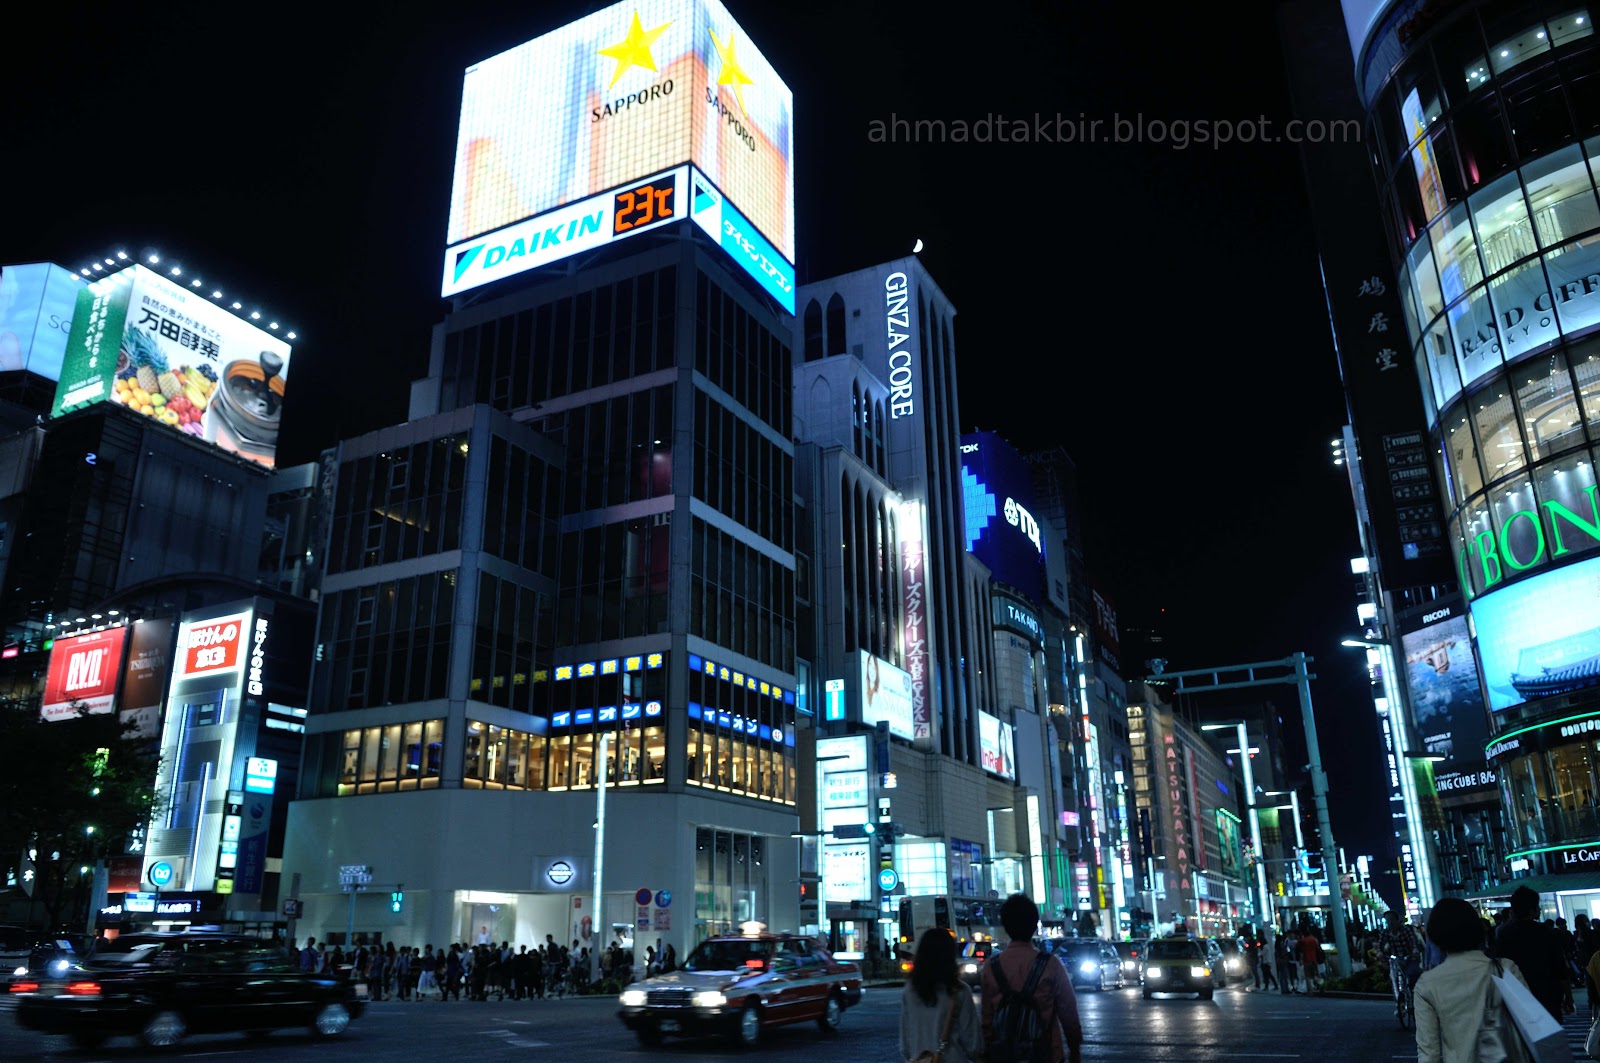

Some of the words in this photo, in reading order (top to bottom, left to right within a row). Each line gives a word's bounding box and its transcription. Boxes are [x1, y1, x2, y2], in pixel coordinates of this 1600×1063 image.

[592, 79, 674, 123] SAPPORO
[705, 87, 756, 152] SAPPORO
[483, 210, 604, 270] DAIKIN
[885, 271, 911, 350] GINZA
[1358, 275, 1399, 372] 鳩居堂
[138, 306, 220, 363] 万田酵素
[1480, 316, 1550, 362] TOKYO
[888, 349, 914, 420] CORE
[1007, 605, 1038, 634] TAKANO
[1422, 607, 1451, 624] RICOH
[65, 648, 103, 692] B.V.D.
[555, 652, 662, 681] 英会話留学
[552, 703, 641, 727] イーオン
[704, 709, 758, 734] イーオン
[1453, 773, 1477, 789] CUBE
[1164, 735, 1191, 890] MATSUZAKAYA
[1563, 851, 1577, 864] LE
